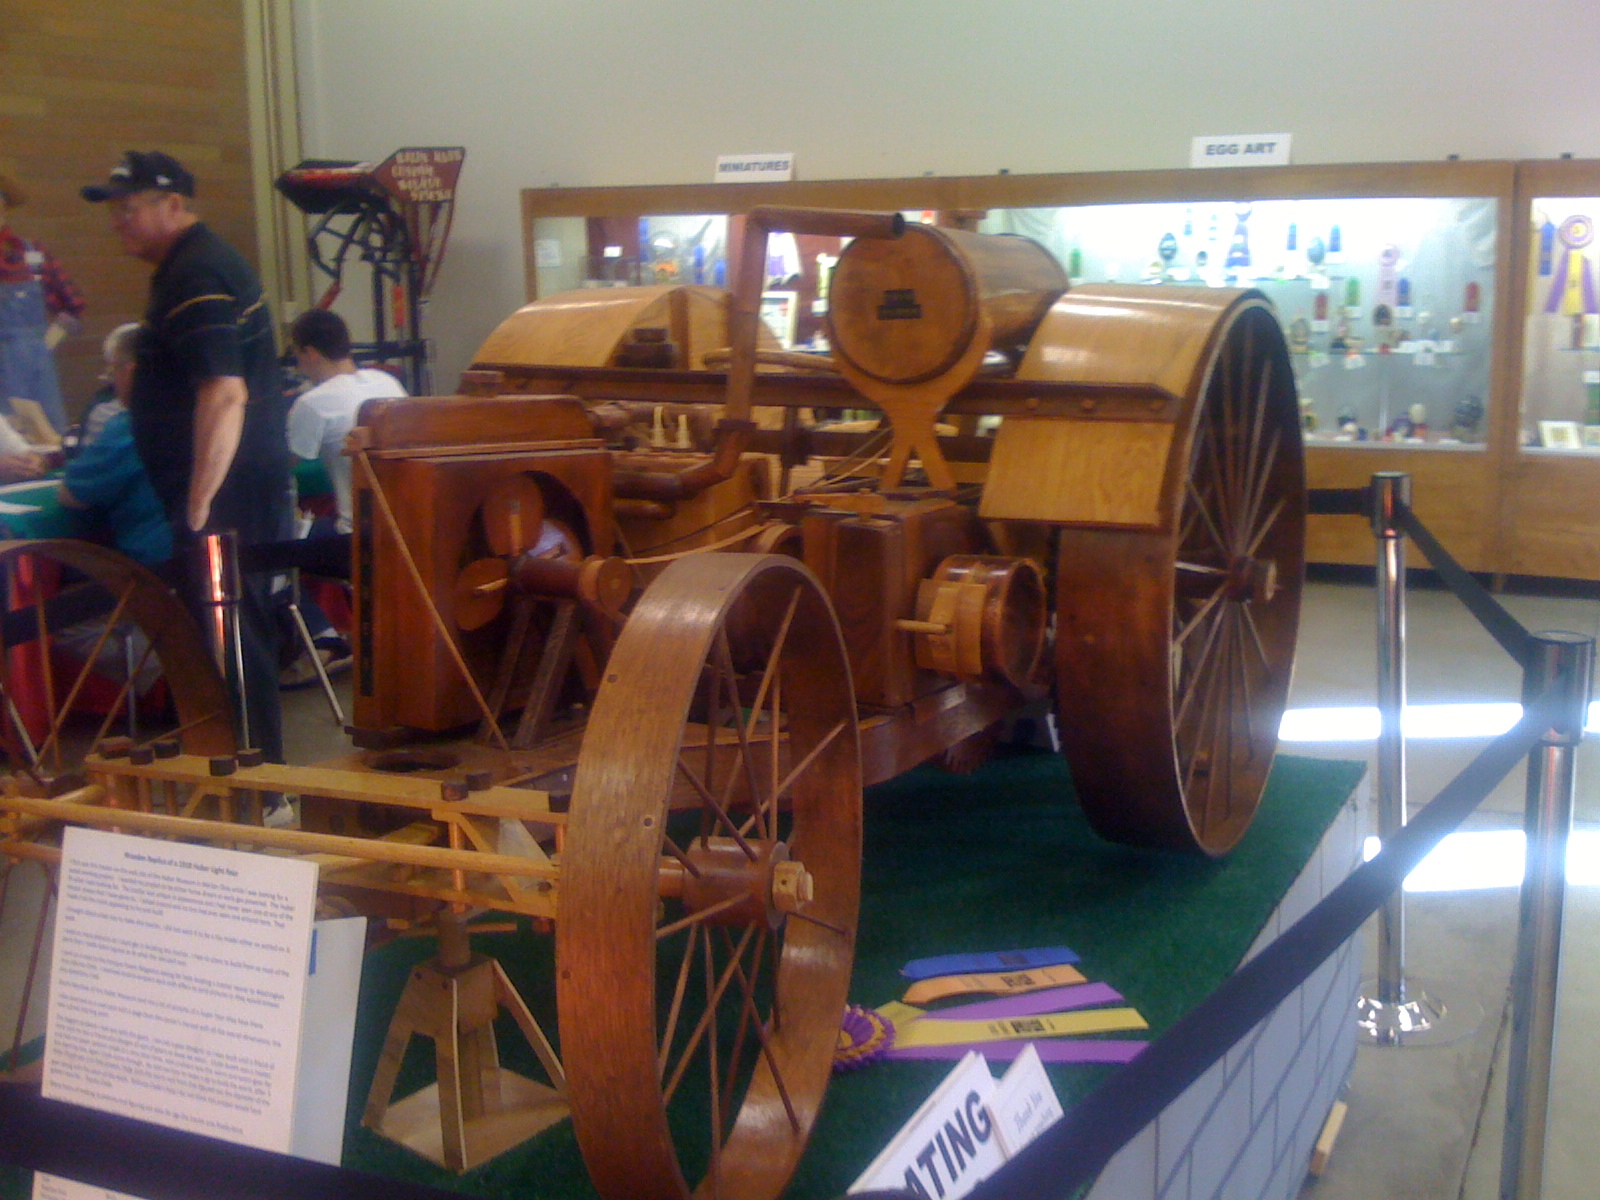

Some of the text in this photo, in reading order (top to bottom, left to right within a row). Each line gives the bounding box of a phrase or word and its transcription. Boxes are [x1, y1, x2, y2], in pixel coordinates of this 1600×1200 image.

[1205, 142, 1277, 156] EGG ART
[719, 160, 790, 173] MINIATURES
